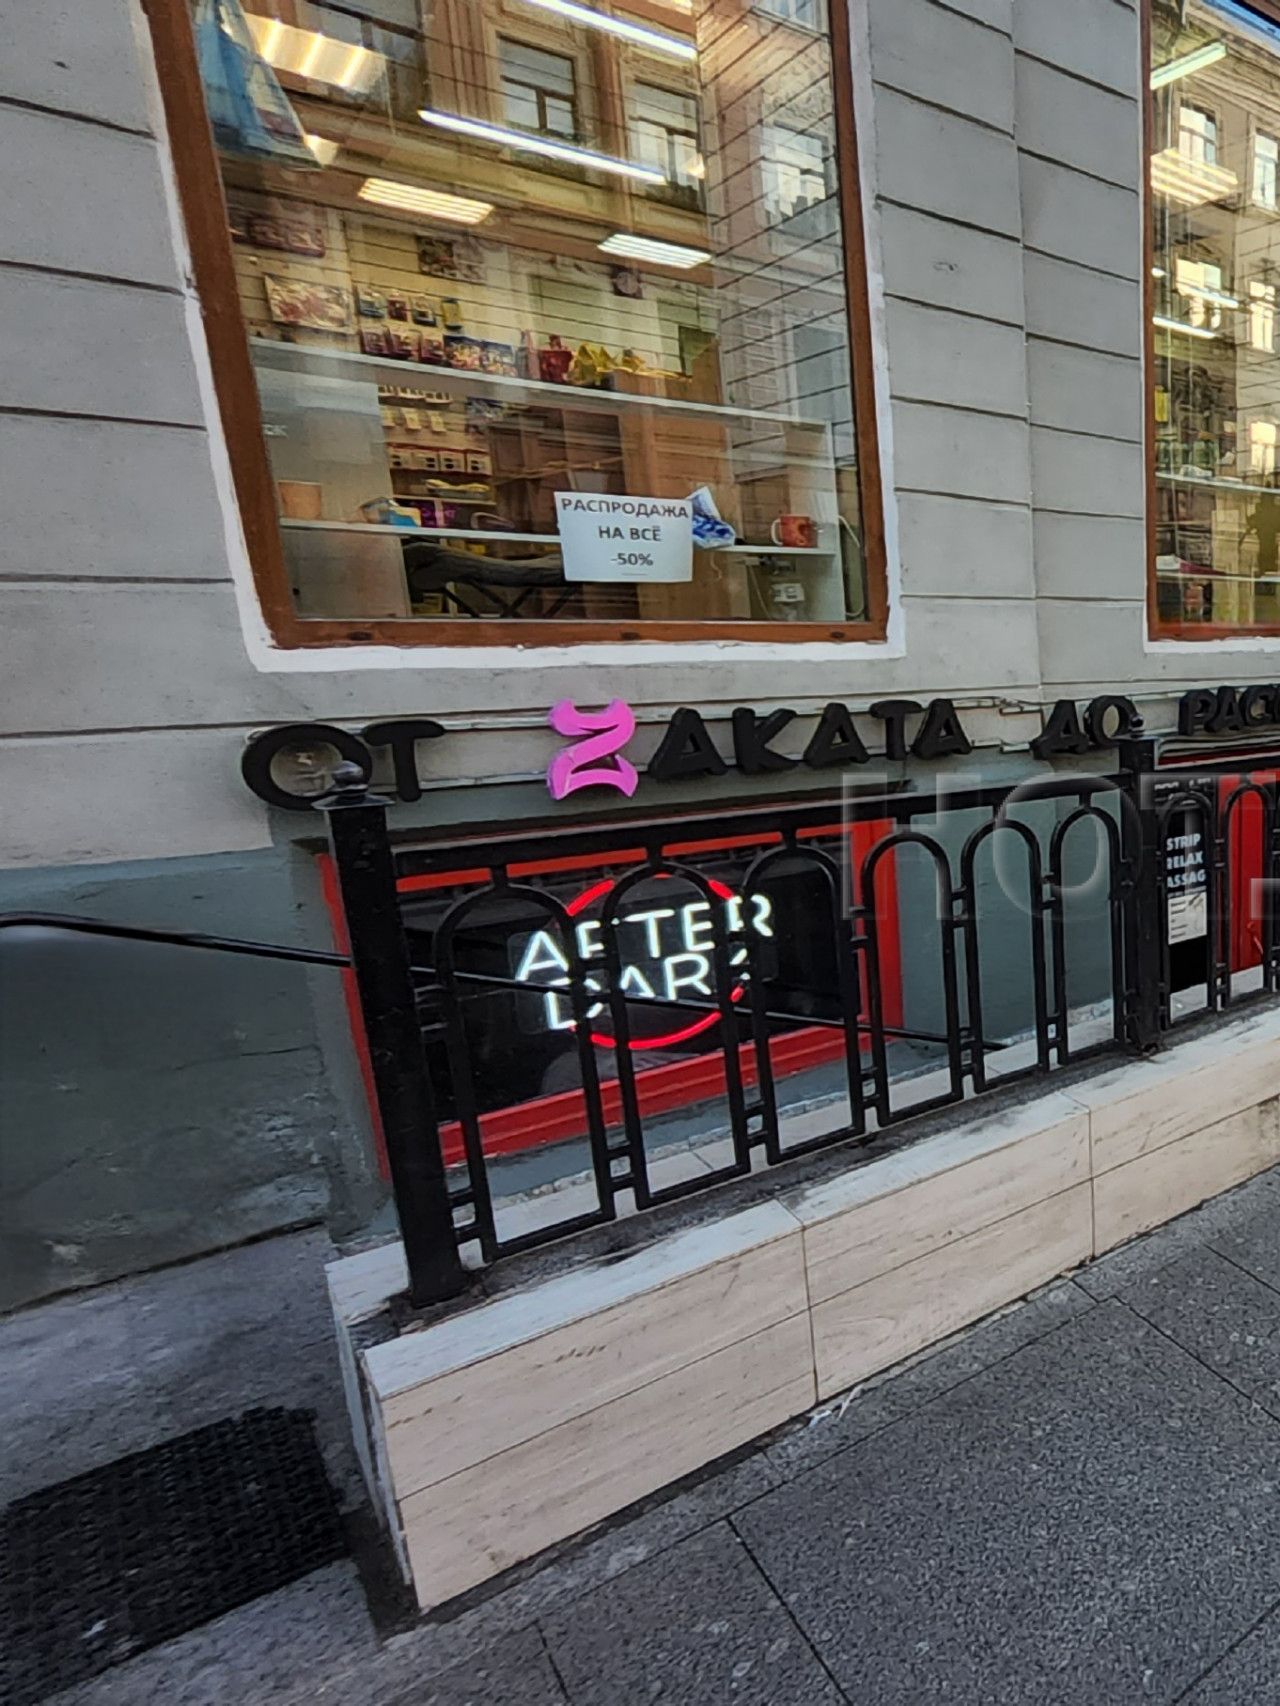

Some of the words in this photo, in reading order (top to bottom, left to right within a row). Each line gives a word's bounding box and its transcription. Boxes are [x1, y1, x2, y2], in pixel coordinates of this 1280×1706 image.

[561, 497, 689, 519] РАСПРОДАЖА
[599, 526, 625, 541] НА
[630, 525, 662, 542] ВСЁ
[610, 552, 654, 567] -50%
[241, 720, 446, 809] ОТ
[1166, 833, 1202, 851] STRIP
